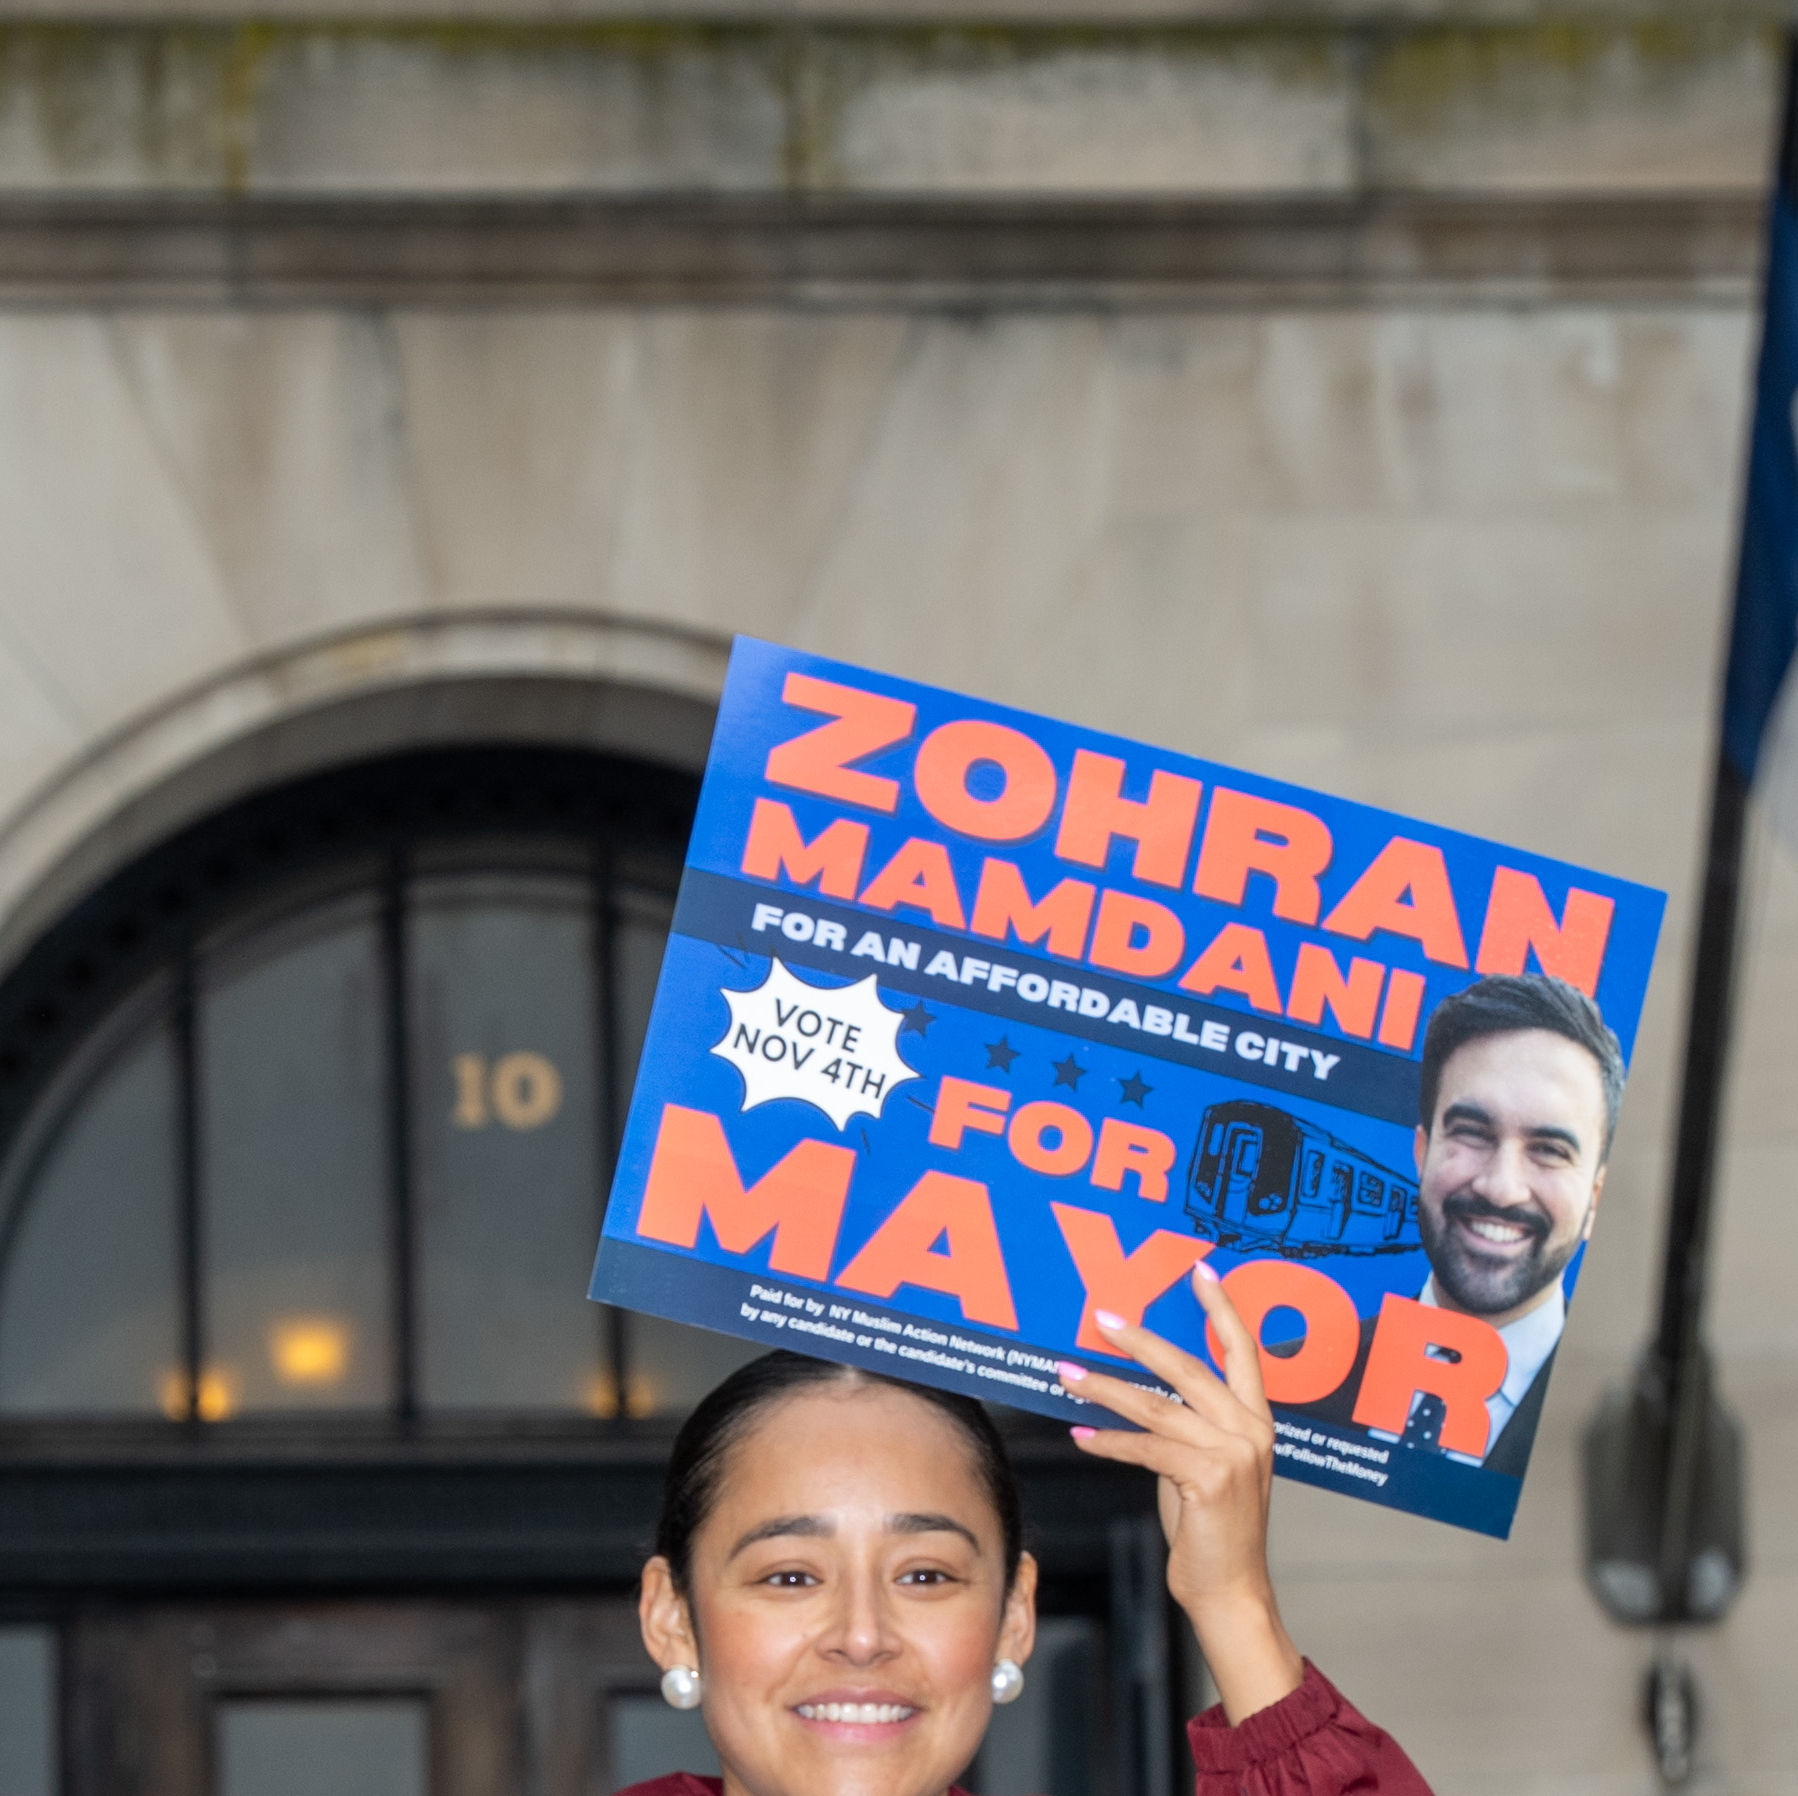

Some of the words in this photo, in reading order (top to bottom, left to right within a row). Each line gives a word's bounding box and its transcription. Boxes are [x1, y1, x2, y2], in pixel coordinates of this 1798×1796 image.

[764, 672, 1615, 999] ZOHRAN
[741, 798, 1425, 1052] MAMDANI
[750, 902, 848, 954] FOR
[849, 930, 922, 972] AN
[923, 948, 1232, 1054] AFFORDABLE
[1235, 1030, 1342, 1081] CITY
[775, 997, 862, 1053] VOTE
[453, 1052, 563, 1132] 10
[733, 1022, 815, 1071] NOV
[820, 1057, 887, 1100] 4TH
[928, 1076, 1177, 1203] FOR
[636, 1102, 1511, 1459] MAYOR
[749, 1283, 783, 1304] Paid
[783, 1291, 805, 1310] for
[805, 1298, 825, 1317] by
[828, 1304, 852, 1321] NY
[851, 1309, 903, 1335] Muslim
[902, 1322, 948, 1347] Action
[948, 1334, 1006, 1362] Network
[740, 1301, 760, 1322] by
[759, 1310, 788, 1329] any
[787, 1315, 856, 1344] candidate
[856, 1333, 873, 1348] or
[873, 1336, 898, 1355] the
[898, 1345, 976, 1375] candidate's
[976, 1364, 1049, 1394] committee
[1049, 1381, 1065, 1398] or
[1311, 1432, 1328, 1447] or
[1326, 1436, 1390, 1465] requested
